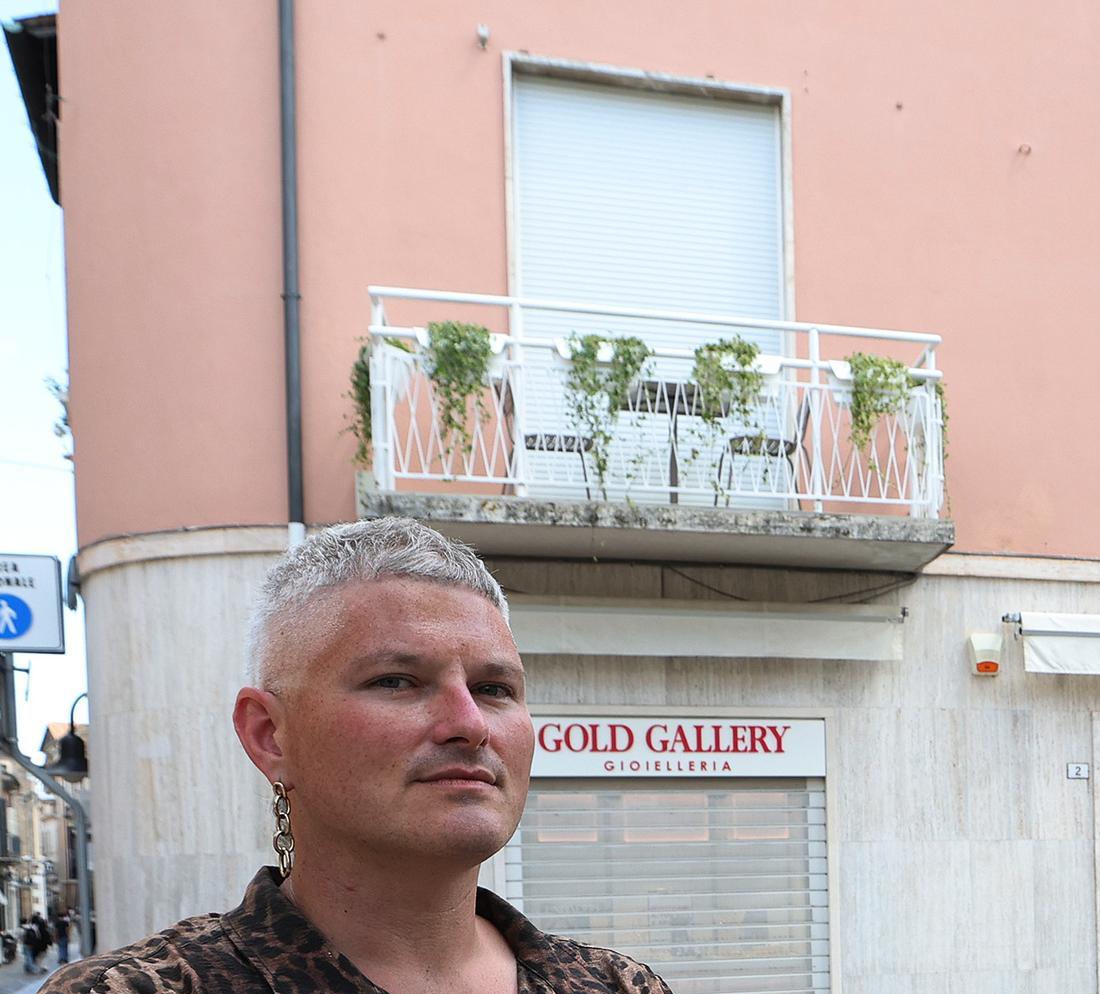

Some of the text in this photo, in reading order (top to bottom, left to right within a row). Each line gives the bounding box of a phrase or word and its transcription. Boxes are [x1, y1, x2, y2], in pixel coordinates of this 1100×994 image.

[538, 723, 791, 753] GOLD GALLERY
[604, 760, 732, 772] GIOIELLERIA
[1075, 766, 1082, 776] 2
